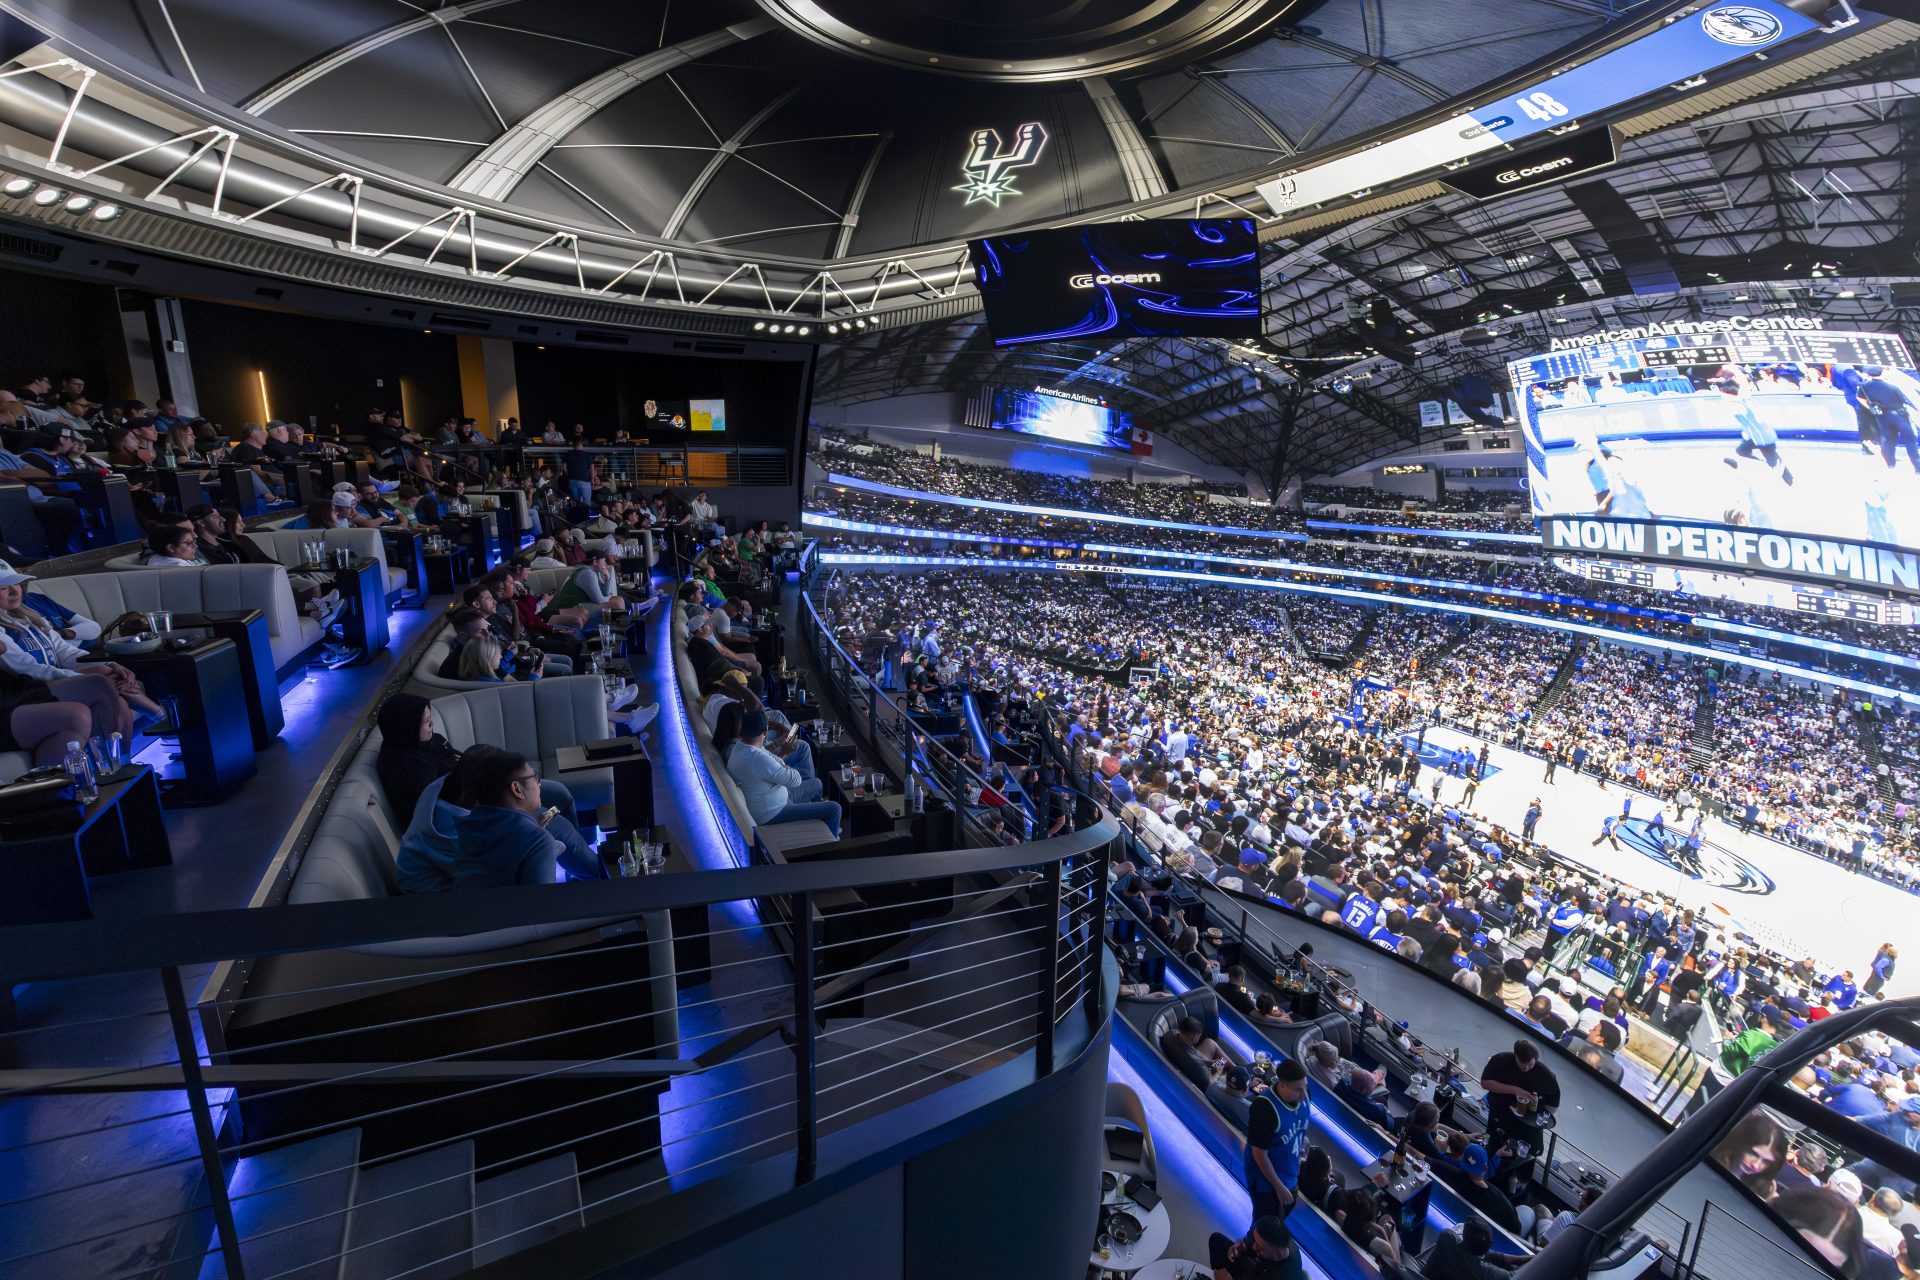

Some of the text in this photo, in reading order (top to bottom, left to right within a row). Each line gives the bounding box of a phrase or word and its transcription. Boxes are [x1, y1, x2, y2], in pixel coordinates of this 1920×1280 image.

[1516, 92, 1569, 122] 48
[1465, 119, 1507, 138] 2nd Quarter
[1096, 273, 1161, 285] cosm
[1034, 385, 1099, 405] American Airlines
[1552, 519, 1920, 591] NOW PERFORMIN
[1345, 906, 1367, 928] 13
